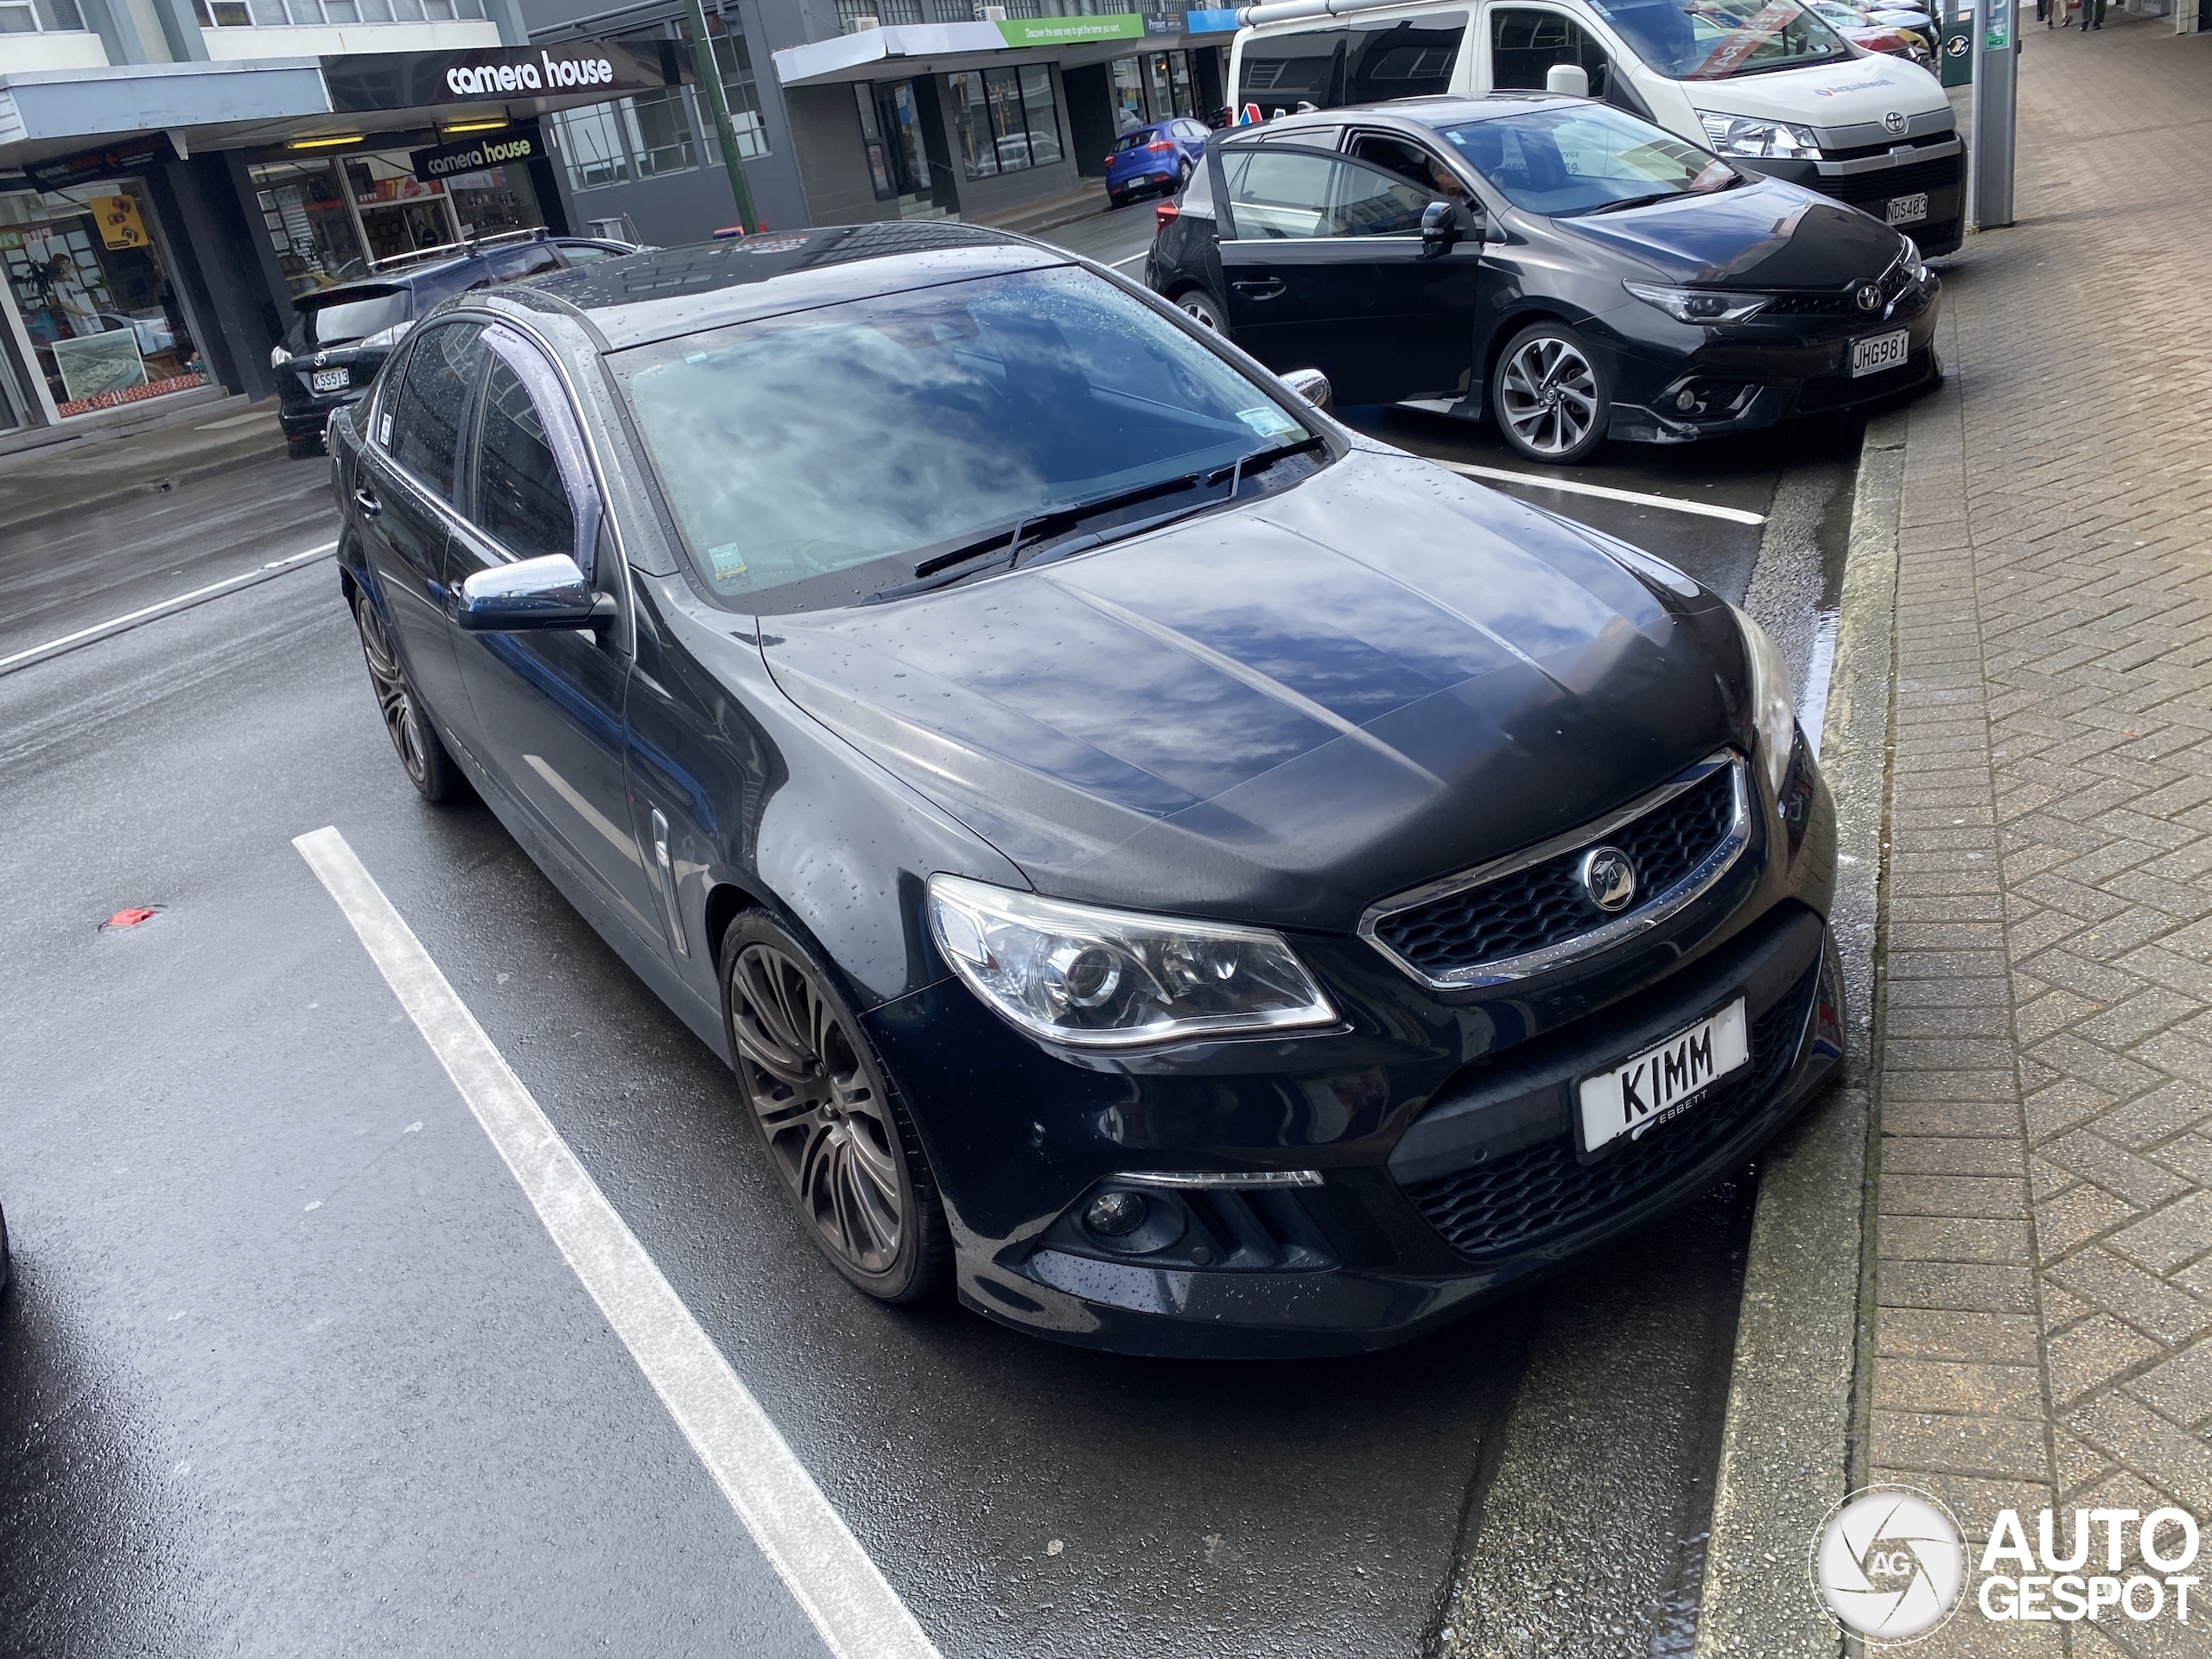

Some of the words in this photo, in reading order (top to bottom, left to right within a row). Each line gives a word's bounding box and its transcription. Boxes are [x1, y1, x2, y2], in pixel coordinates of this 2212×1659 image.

[1026, 28, 1045, 38] Discover
[1052, 28, 1064, 38] easy
[1090, 24, 1103, 34] home
[447, 63, 542, 95] camera
[541, 50, 613, 87] house
[428, 150, 484, 175] camera
[482, 139, 531, 162] house
[1888, 198, 1927, 221] NDS403
[1854, 336, 1905, 369] JHG981
[314, 371, 348, 388] KSS513
[1621, 1025, 1713, 1125] KIMM
[1659, 1090, 1708, 1124] EBBETT
